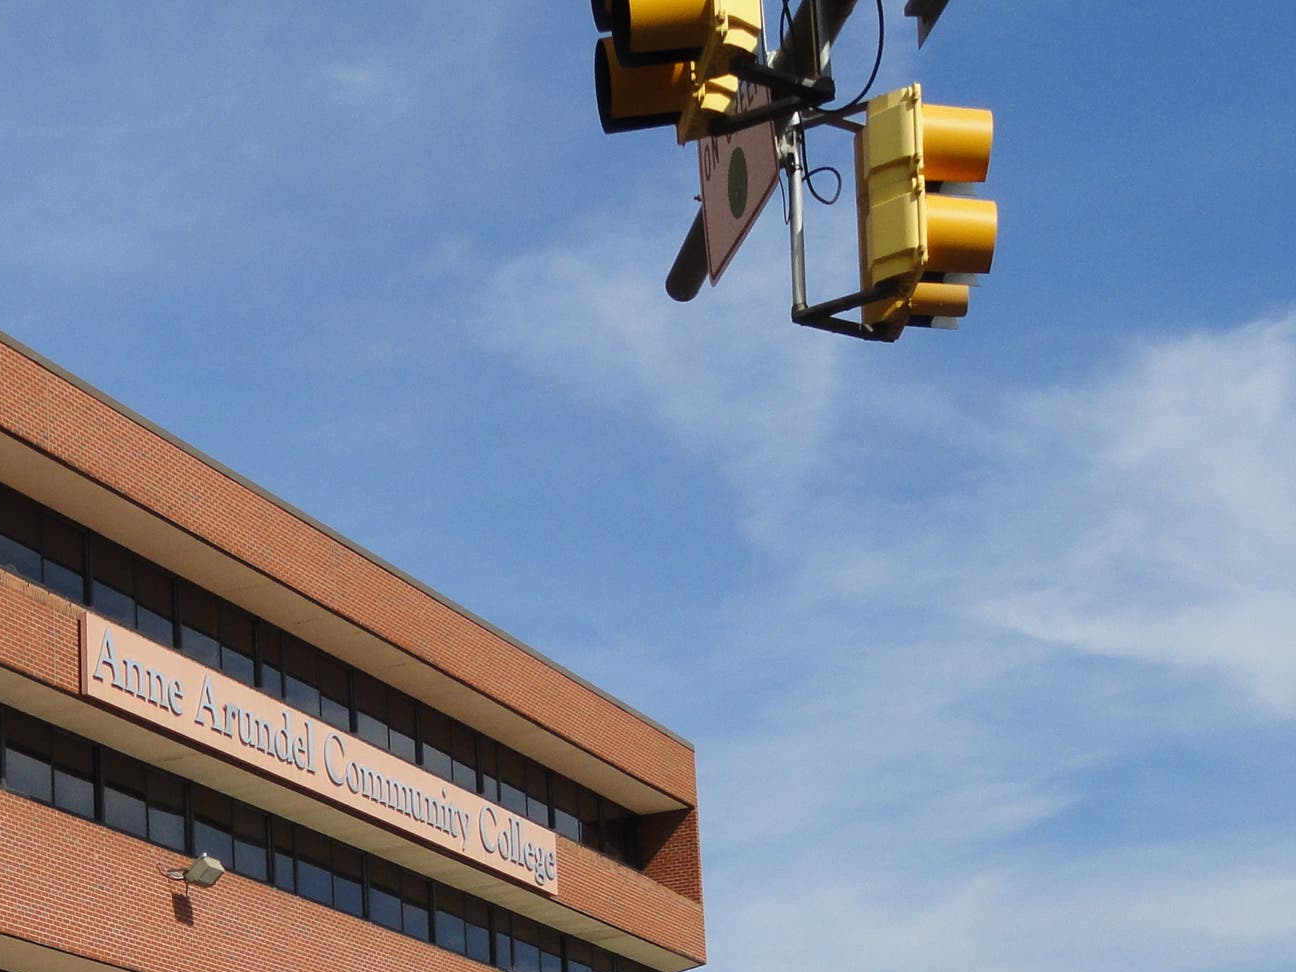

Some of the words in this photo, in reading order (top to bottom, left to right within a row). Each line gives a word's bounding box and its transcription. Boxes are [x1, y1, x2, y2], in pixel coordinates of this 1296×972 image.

[93, 627, 185, 716] Anne
[194, 674, 316, 775] Arundel
[324, 733, 469, 852] Community
[479, 804, 557, 886] College
